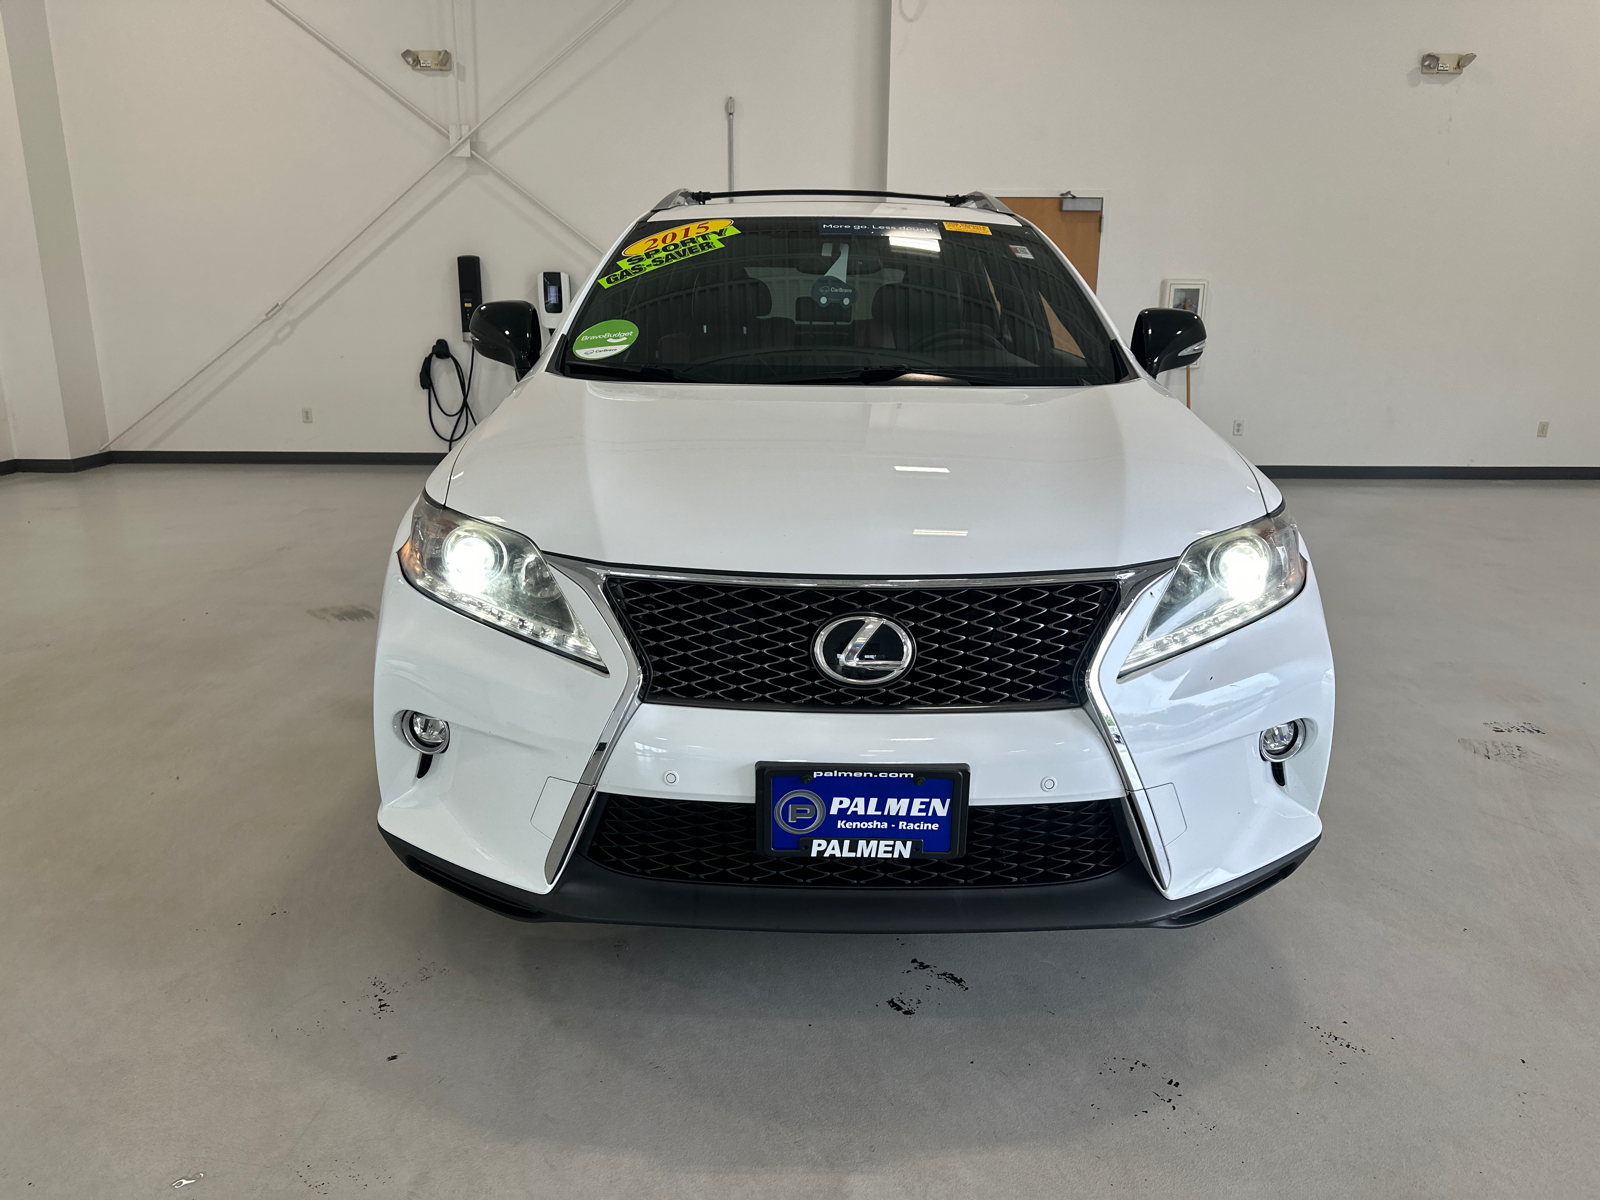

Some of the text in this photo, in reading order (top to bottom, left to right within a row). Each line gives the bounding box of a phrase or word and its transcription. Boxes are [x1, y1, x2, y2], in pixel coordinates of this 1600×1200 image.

[626, 227, 727, 266] SPORTY
[644, 222, 710, 252] 2015
[605, 241, 716, 285] GAS-SAVER
[580, 331, 634, 342] BravoBudget
[813, 770, 914, 779] palmen.com
[829, 797, 951, 817] PALMEN
[837, 820, 888, 829] Kenosha
[898, 821, 939, 831] Racine
[810, 839, 912, 858] PALMEN
